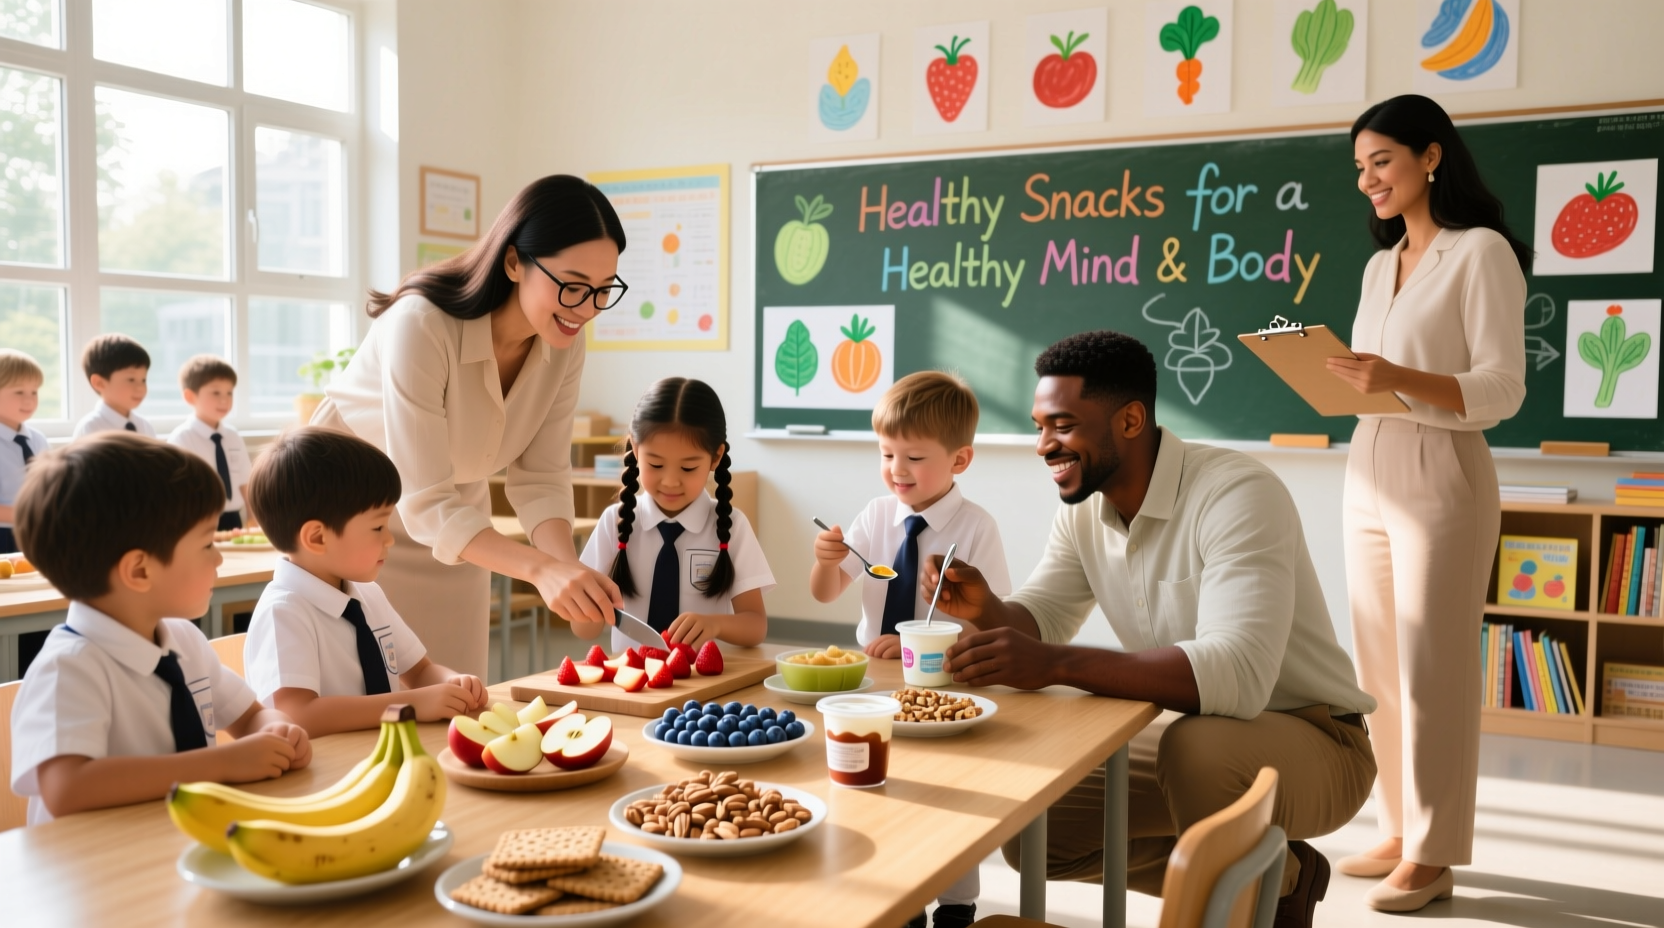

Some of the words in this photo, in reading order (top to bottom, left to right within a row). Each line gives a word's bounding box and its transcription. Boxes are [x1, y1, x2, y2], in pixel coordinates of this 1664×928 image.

[858, 176, 1005, 242] Healthy
[1020, 169, 1166, 223] Snacks
[1185, 162, 1258, 232] for
[1275, 181, 1310, 211] a
[881, 241, 1026, 308] Healthy
[1039, 234, 1140, 286] Mind
[1156, 237, 1188, 283] &
[1207, 229, 1321, 304] Body
